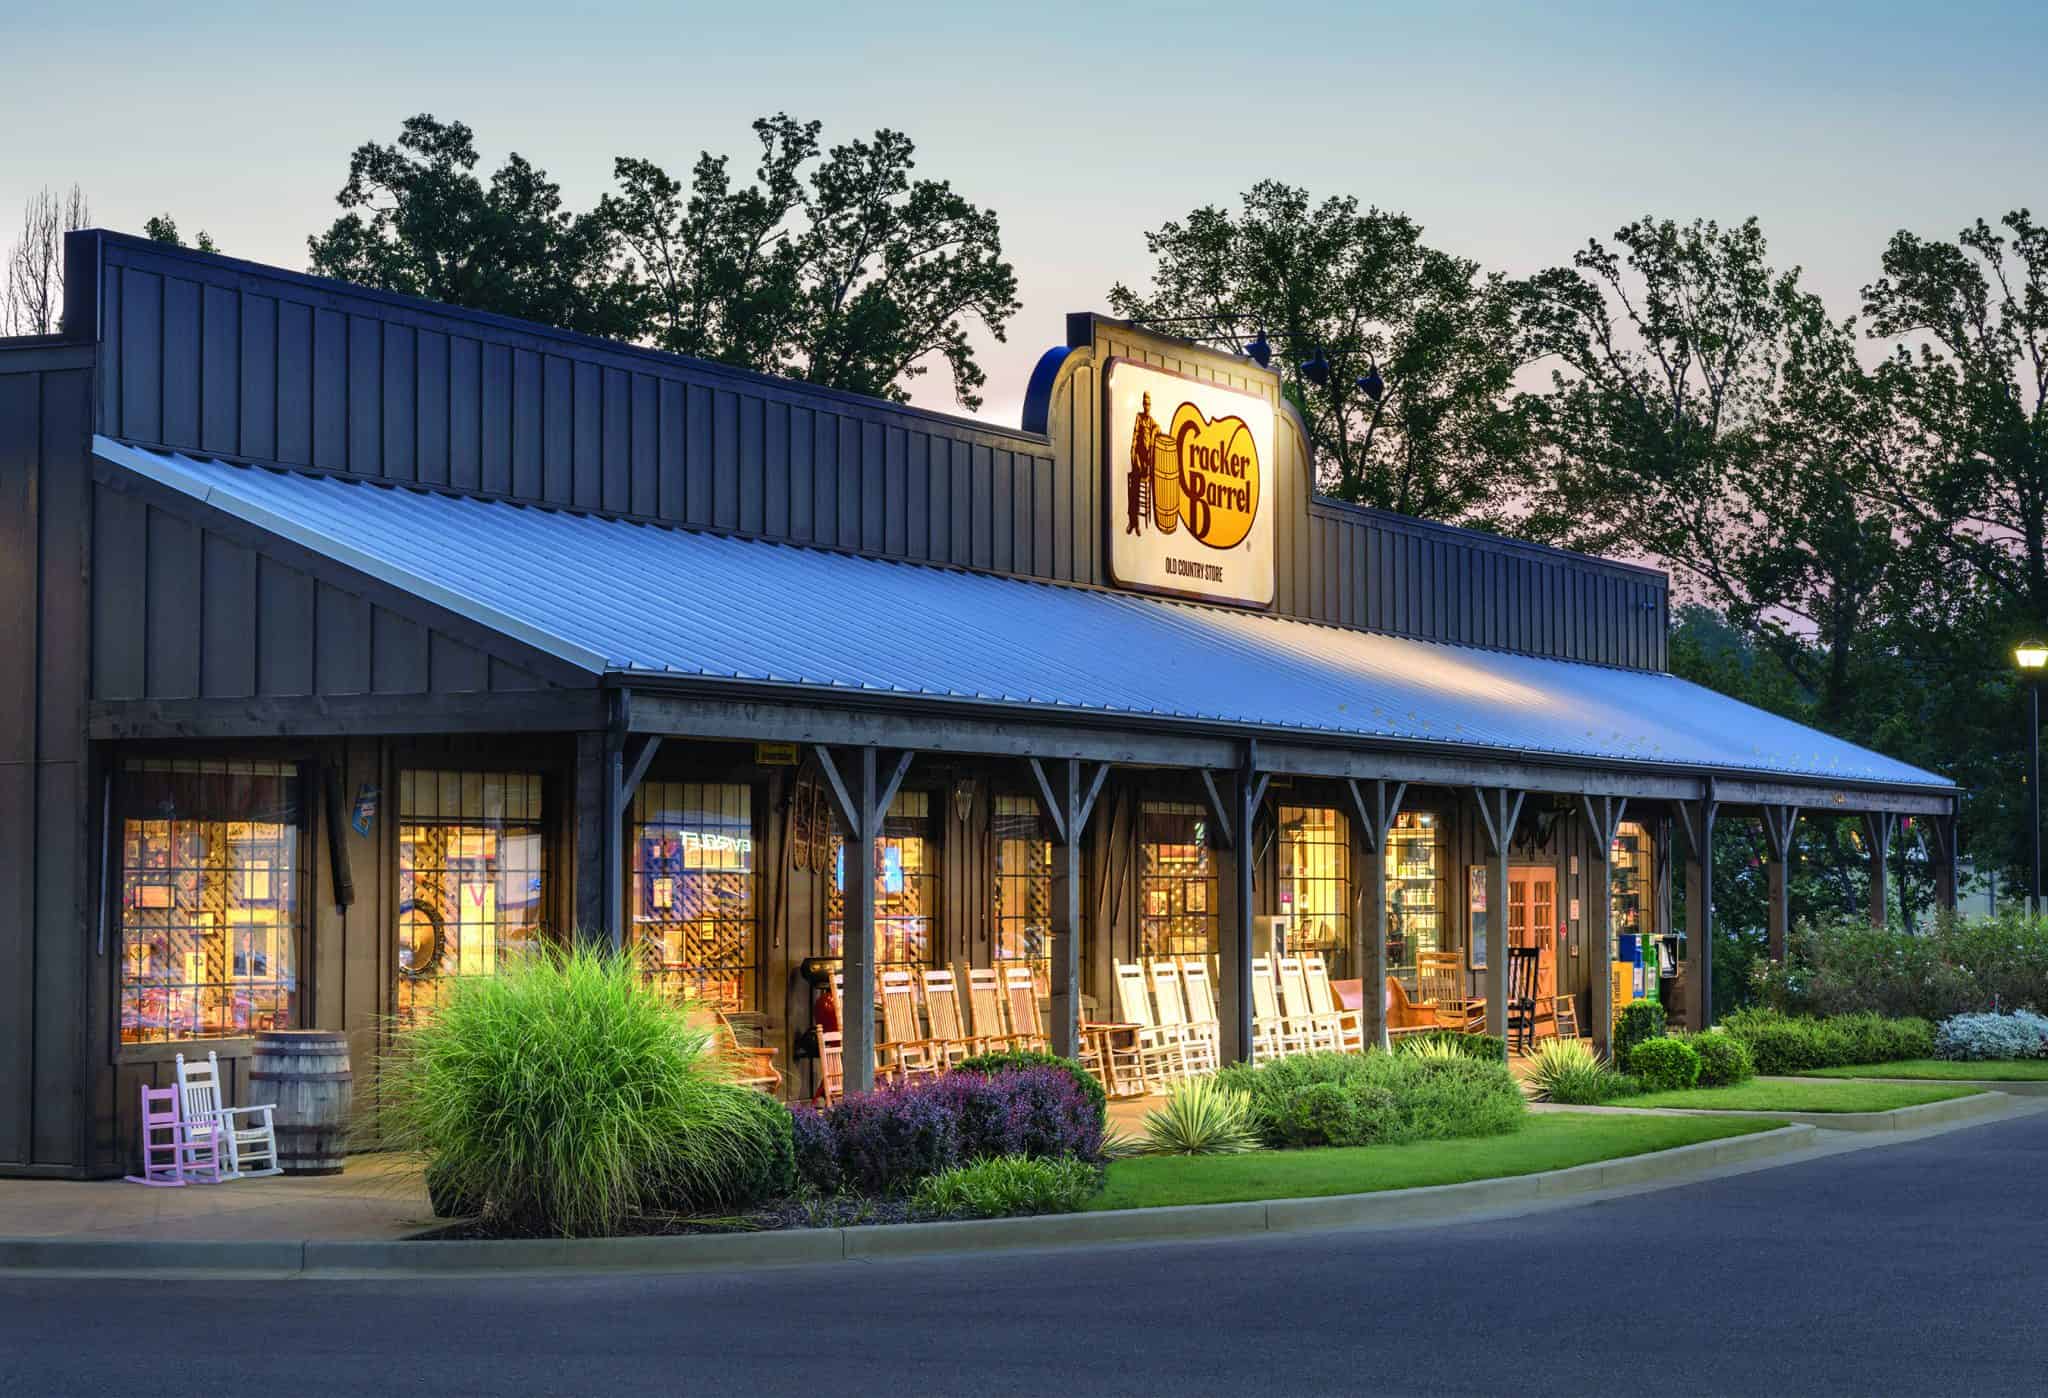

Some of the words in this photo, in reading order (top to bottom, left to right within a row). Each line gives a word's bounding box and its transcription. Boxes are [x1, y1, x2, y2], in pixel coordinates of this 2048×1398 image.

[1176, 420, 1250, 499] Cracker
[1189, 470, 1250, 540] Barrel
[1165, 556, 1177, 574] OLD
[1178, 560, 1204, 579] COUNTRY
[1205, 563, 1223, 583] STORE
